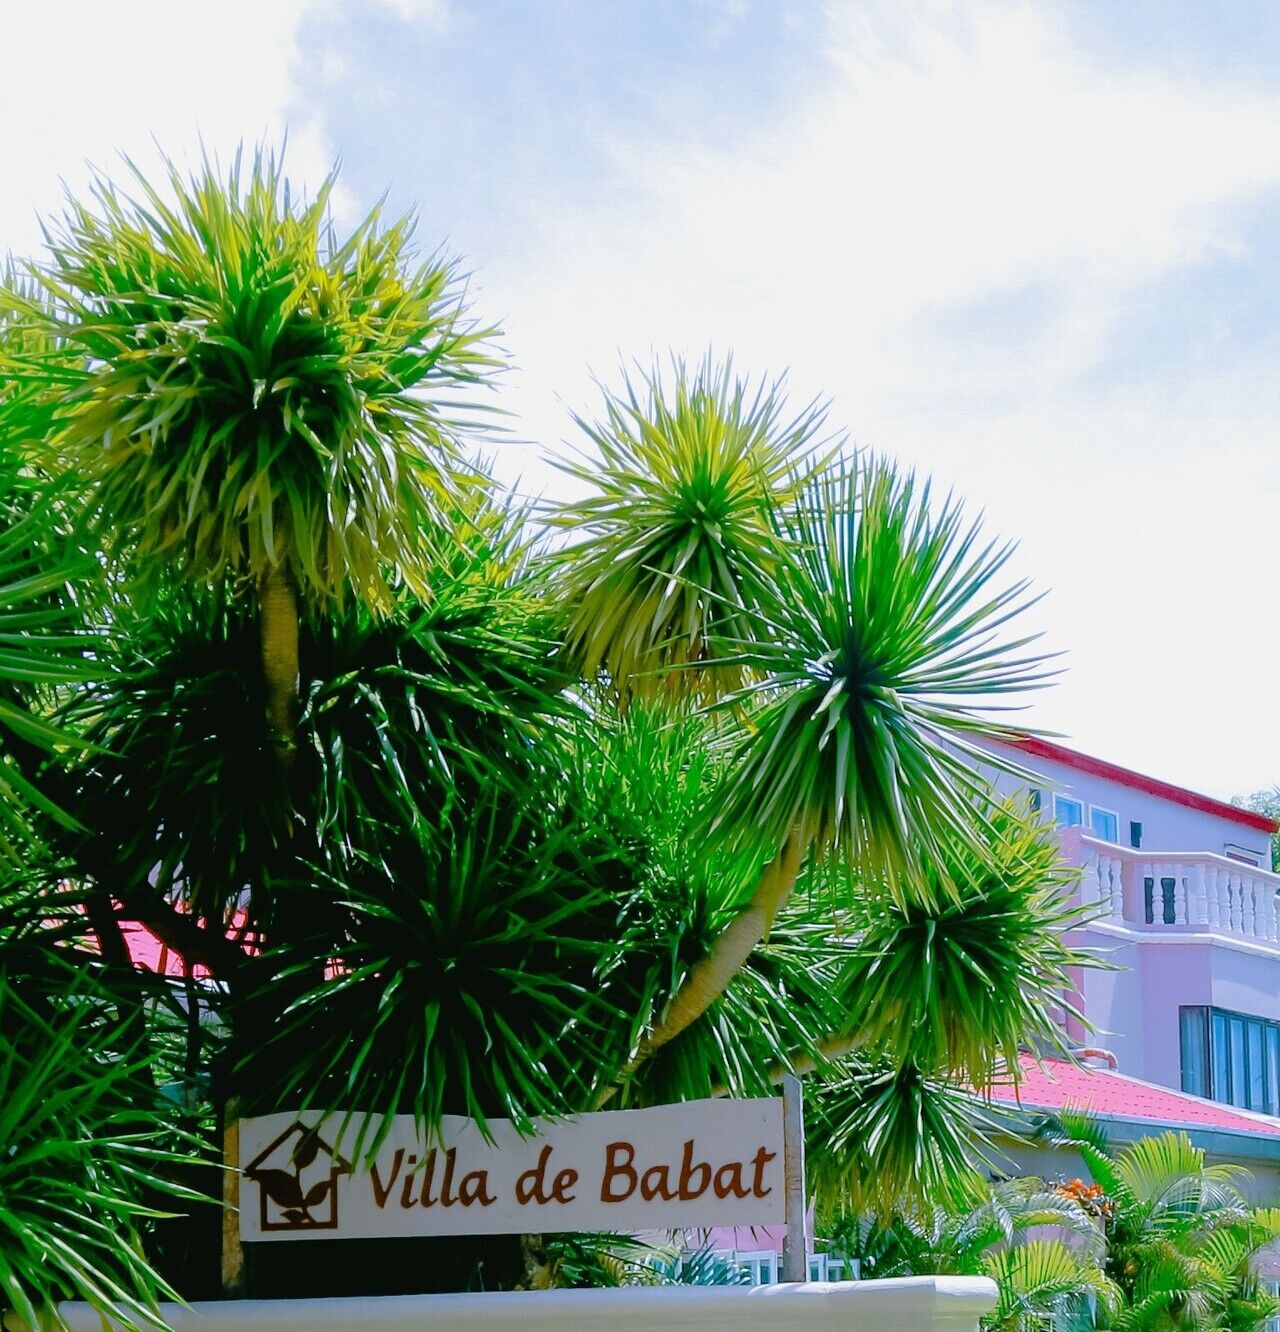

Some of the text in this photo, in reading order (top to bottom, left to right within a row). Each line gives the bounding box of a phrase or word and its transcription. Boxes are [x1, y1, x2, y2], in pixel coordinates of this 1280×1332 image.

[368, 1139, 777, 1209] Villa de Babat
